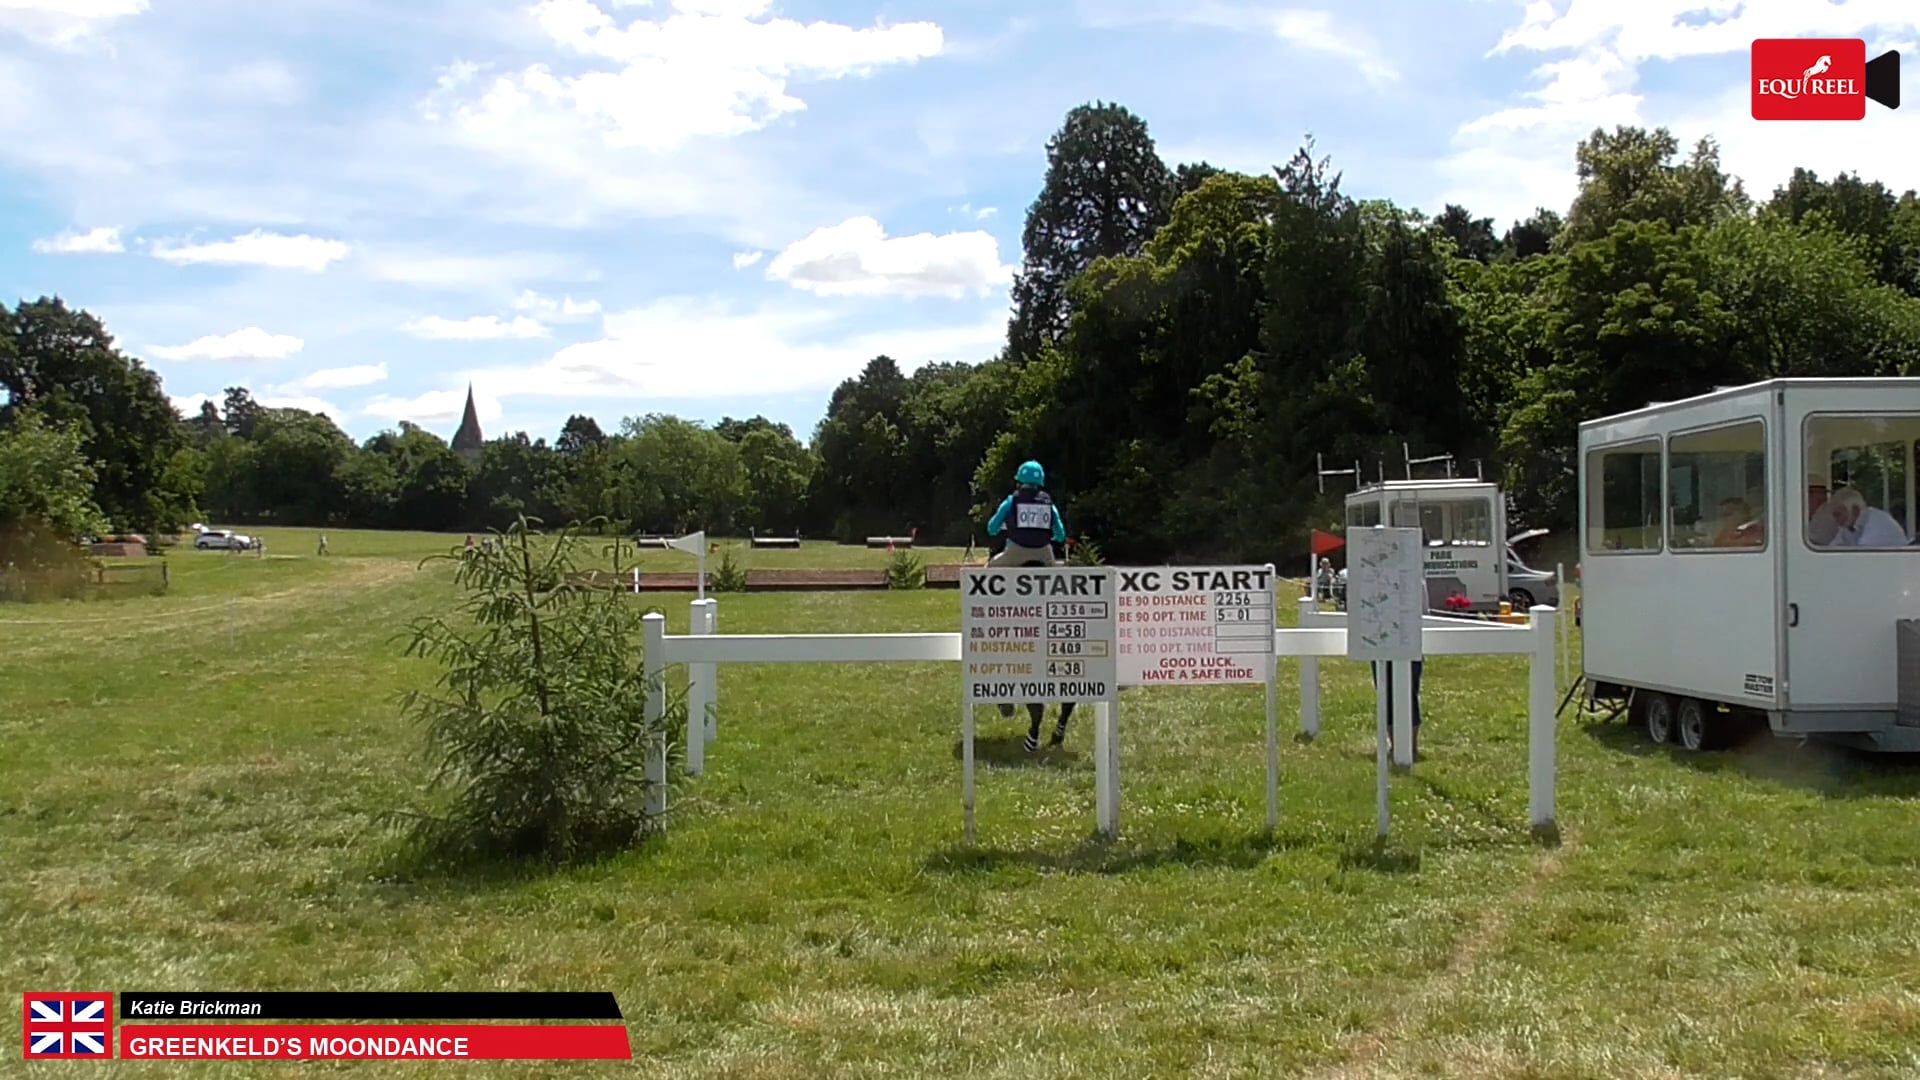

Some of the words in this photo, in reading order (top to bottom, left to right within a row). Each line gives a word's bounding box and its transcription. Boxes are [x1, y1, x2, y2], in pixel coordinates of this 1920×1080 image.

[1021, 511, 1050, 523] 070
[968, 574, 1006, 596] XC
[1016, 574, 1107, 596] START
[1119, 571, 1161, 592] XC
[1172, 570, 1271, 591] START
[1119, 596, 1132, 607] BE
[1136, 596, 1149, 606] 90
[1152, 595, 1207, 606] DISTANCE
[1216, 592, 1250, 606] 2256
[988, 606, 1042, 618] DISTANCE
[1119, 612, 1132, 623] BE
[1136, 612, 1150, 622] 90
[1153, 611, 1176, 622] OPT.
[1179, 611, 1207, 622] TIME
[988, 627, 1010, 638] OPT
[1013, 627, 1040, 638] TIME
[1119, 628, 1132, 639] BE
[1137, 628, 1156, 638] 100
[1159, 626, 1214, 638] DISTANCE
[970, 642, 977, 652] N
[981, 641, 1036, 653] DISTANCE
[1051, 643, 1081, 654] 2409
[1119, 643, 1132, 654] BE
[1137, 643, 1156, 654] 100
[1186, 642, 1213, 653] TIME
[1159, 657, 1197, 668] GOOD
[1200, 656, 1236, 668] LUCK.
[970, 663, 977, 674] N
[980, 663, 1003, 674] OPT
[1005, 663, 1032, 674] TIME
[1142, 670, 1175, 681] HAVE
[1178, 669, 1188, 680] A
[1191, 669, 1222, 679] SAFE
[1225, 668, 1254, 679] RIDE
[973, 683, 1016, 698] ENJOY
[1020, 682, 1056, 697] YOUR
[1060, 682, 1105, 697] ROUND
